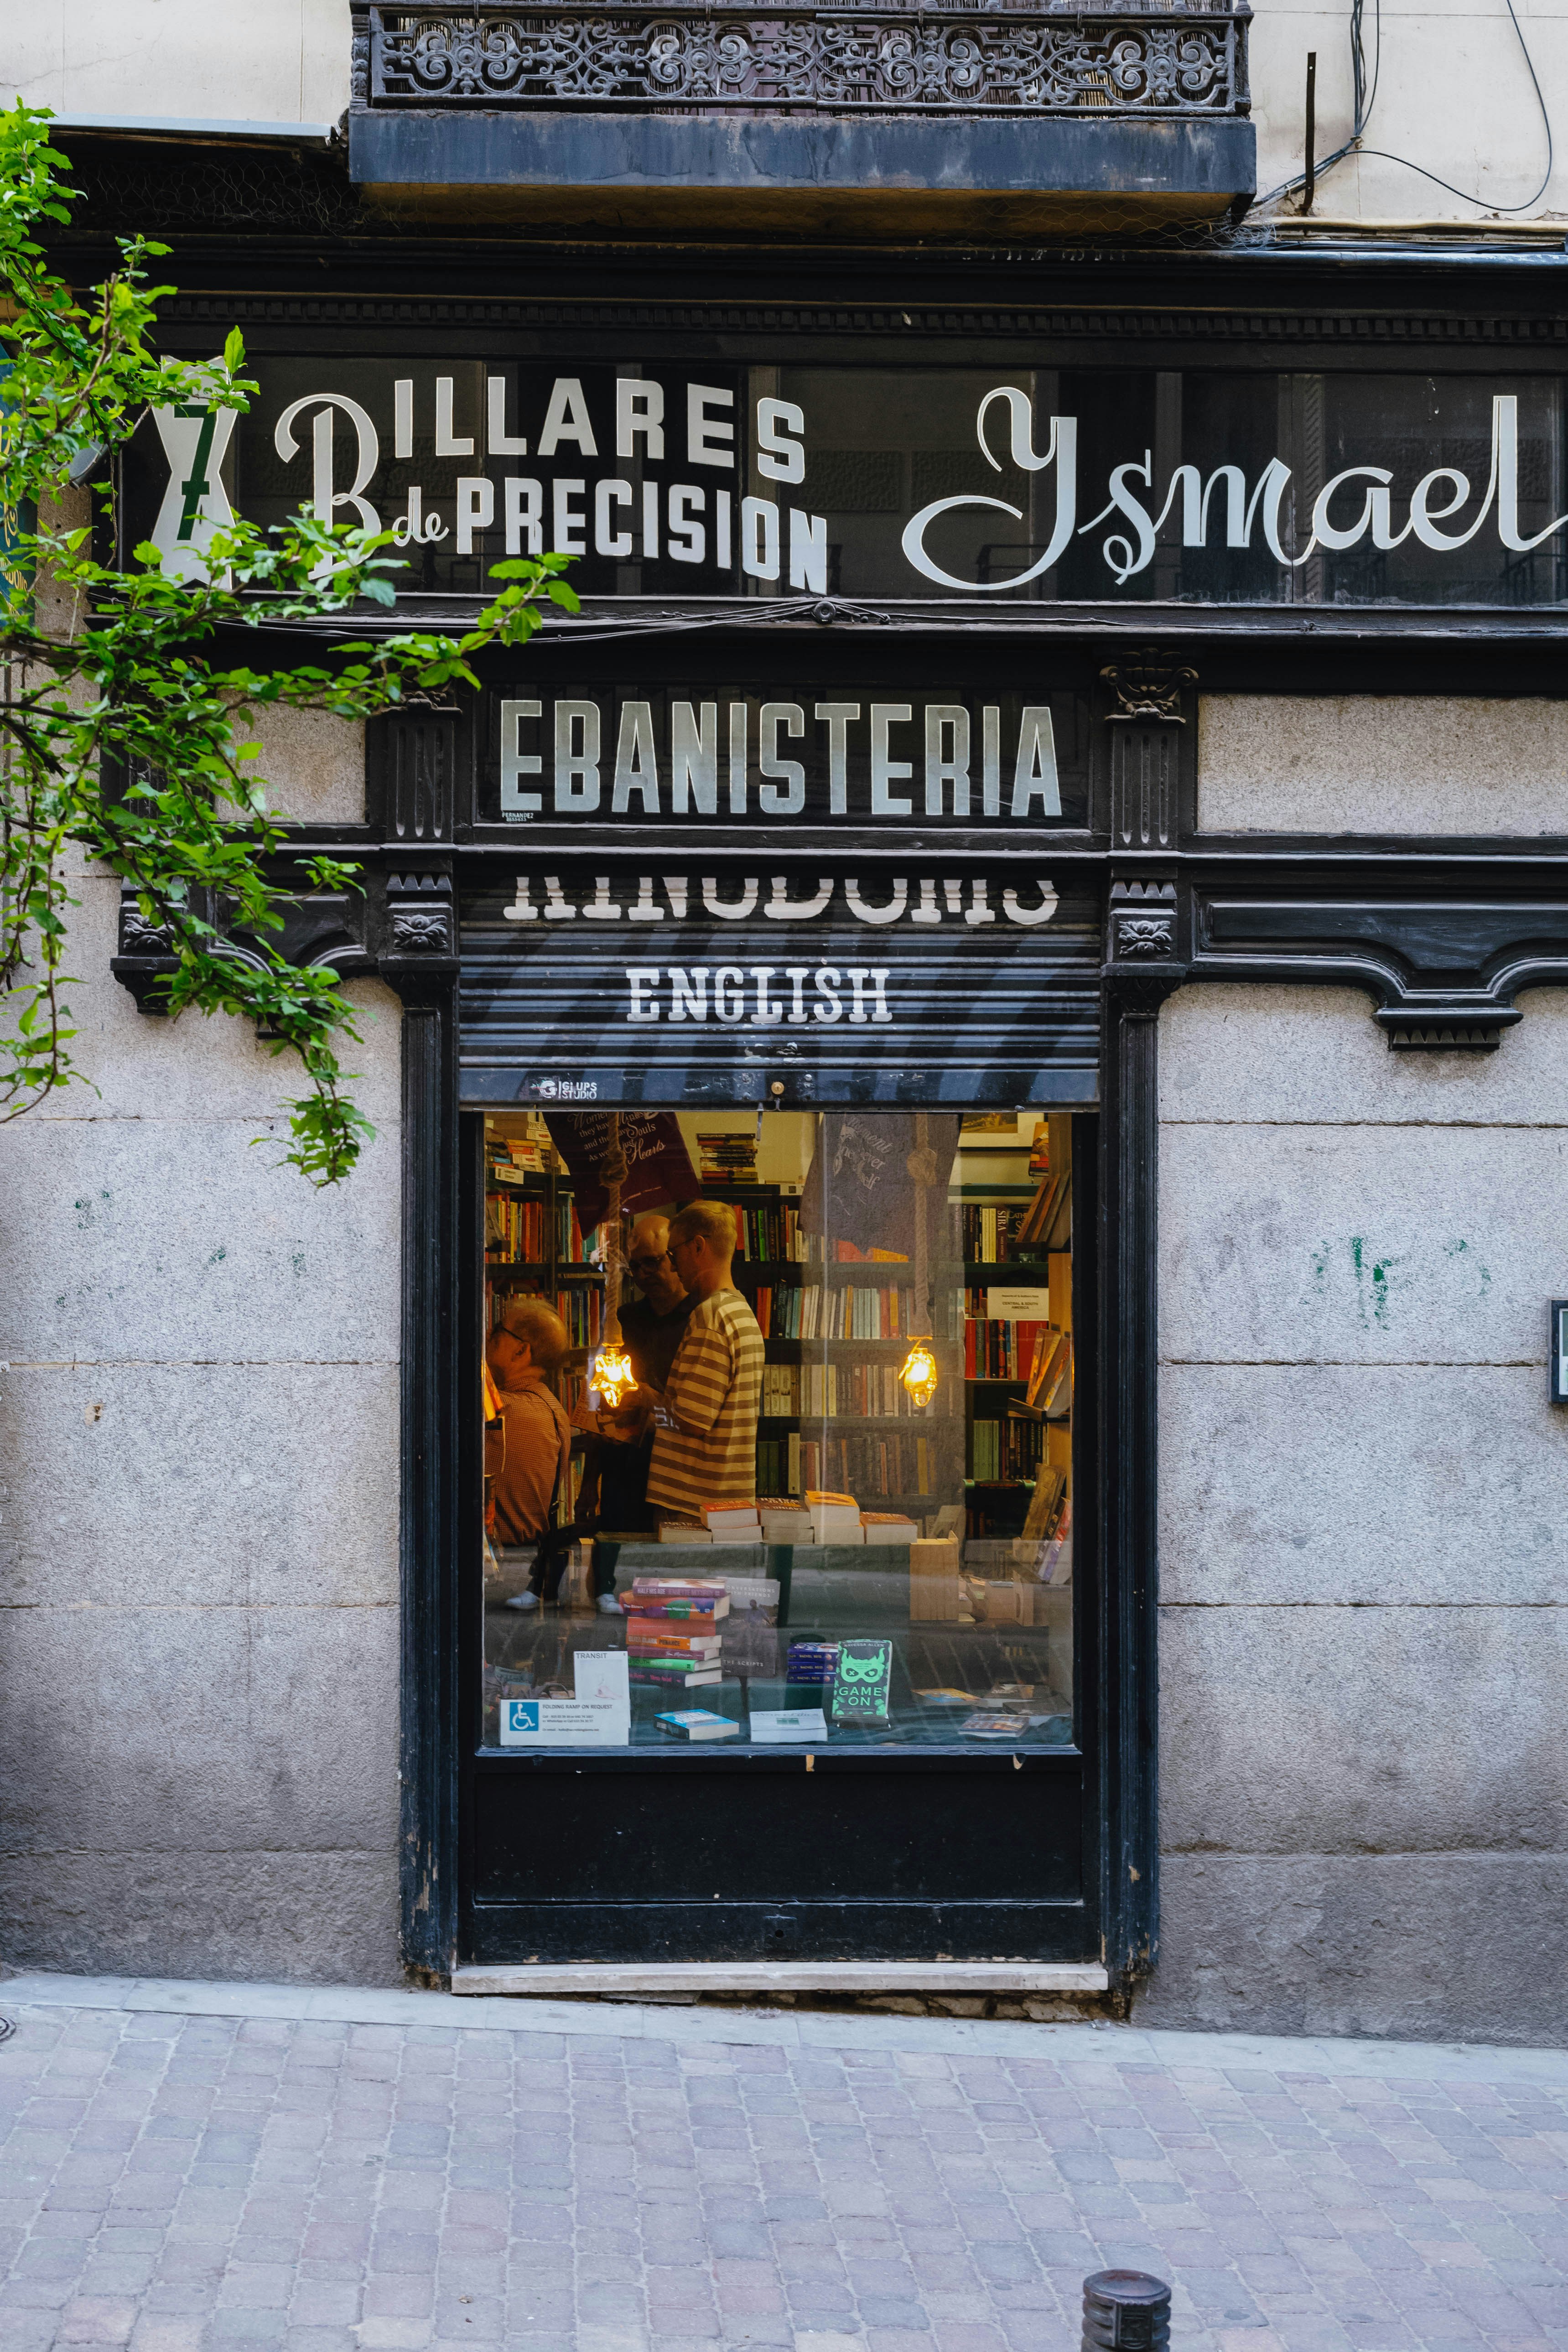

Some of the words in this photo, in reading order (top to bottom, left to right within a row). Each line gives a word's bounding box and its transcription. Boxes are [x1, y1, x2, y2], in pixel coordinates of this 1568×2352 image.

[392, 486, 449, 547] de
[457, 477, 827, 596] PRECISION
[500, 699, 1063, 817] EBANISTERIA
[625, 966, 893, 1024] ENGLISH
[562, 1090, 597, 1100] STUDIO
[997, 1210, 1007, 1231] SIRA
[838, 1687, 883, 1696] GAME
[847, 1697, 871, 1706] ON
